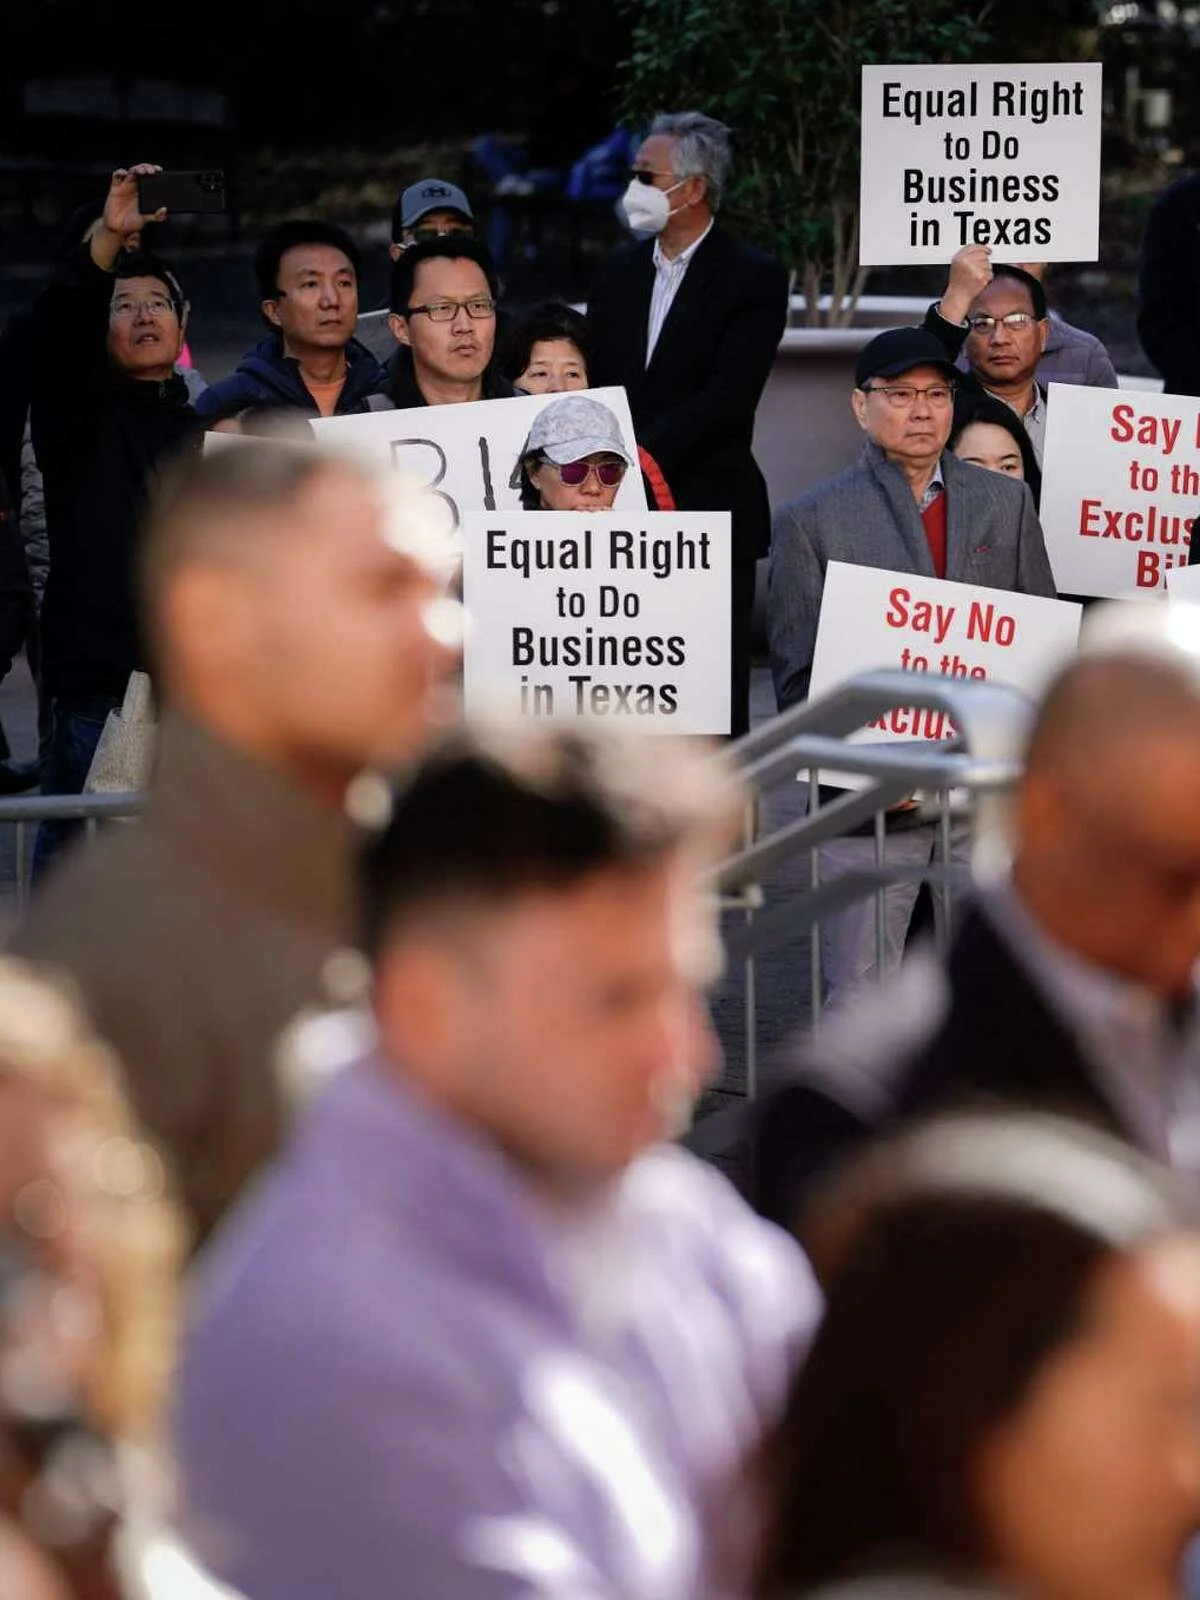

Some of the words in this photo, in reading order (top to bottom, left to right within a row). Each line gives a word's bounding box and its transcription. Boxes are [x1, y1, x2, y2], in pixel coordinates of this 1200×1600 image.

[883, 81, 977, 125] Equal
[993, 81, 1083, 124] Right
[944, 132, 970, 160] to
[982, 130, 1019, 160] Do
[904, 168, 1059, 203] Business
[910, 212, 940, 246] in
[953, 211, 1052, 246] Texas
[1111, 404, 1181, 455] Say
[1129, 460, 1158, 492] to
[486, 530, 592, 578] Equal
[610, 531, 710, 579] Right
[556, 586, 585, 617] to
[599, 585, 640, 617] Do
[886, 588, 955, 644] Say
[967, 601, 1016, 647] No
[512, 627, 685, 667] Business
[901, 648, 928, 673] to
[941, 655, 987, 682] the
[521, 676, 553, 716] in
[569, 676, 678, 715] Texas
